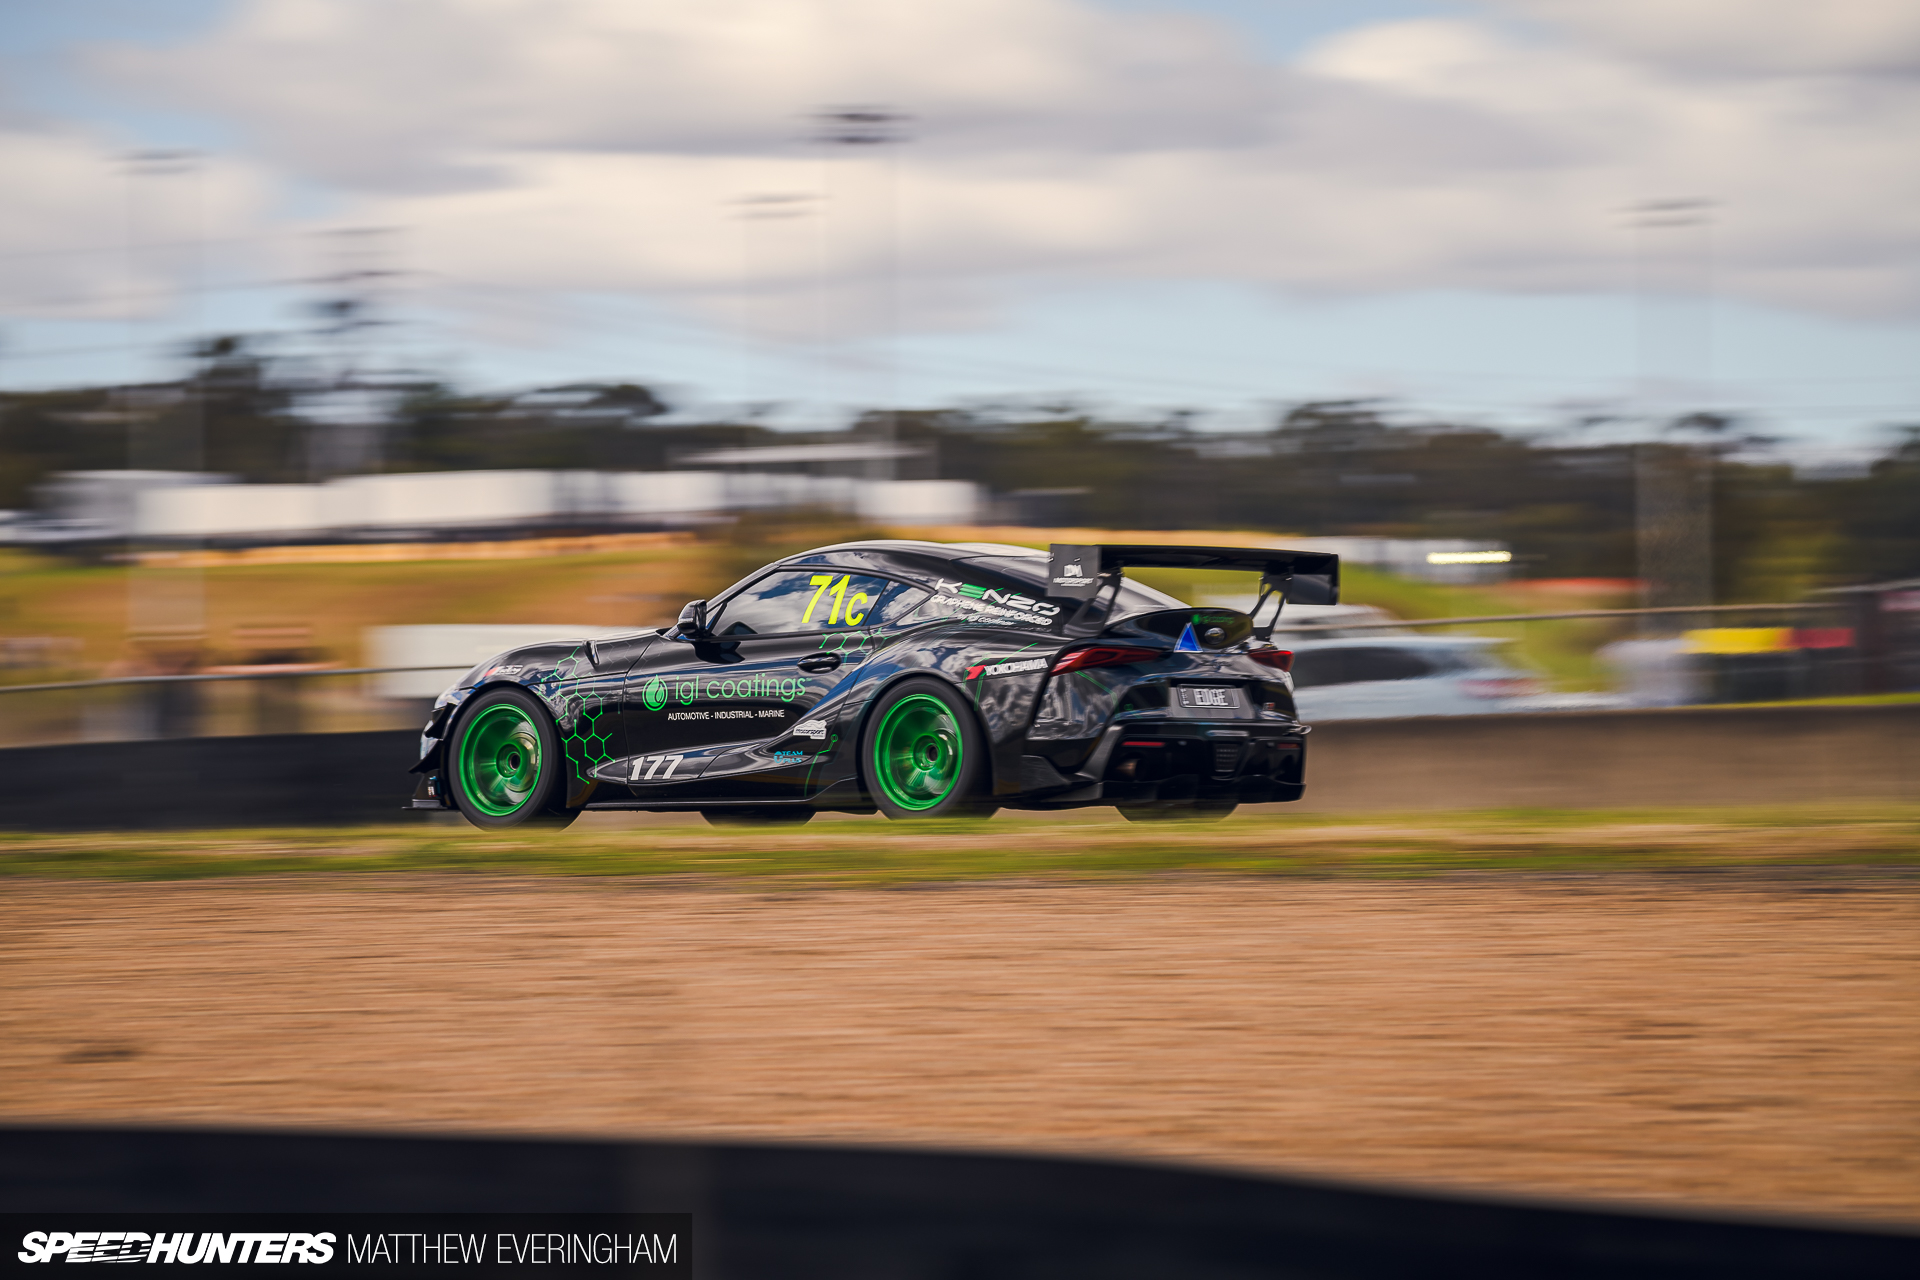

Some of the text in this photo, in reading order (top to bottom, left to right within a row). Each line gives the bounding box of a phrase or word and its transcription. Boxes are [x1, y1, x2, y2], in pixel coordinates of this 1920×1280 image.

[801, 575, 868, 626] 71c
[935, 578, 1060, 615] KENZO
[984, 658, 1048, 676] YOKOHAMA
[675, 672, 806, 705] igl coatings
[668, 709, 785, 721] AUTOMOTIVE INDUSTRIAL MARINE
[630, 754, 684, 781] 177
